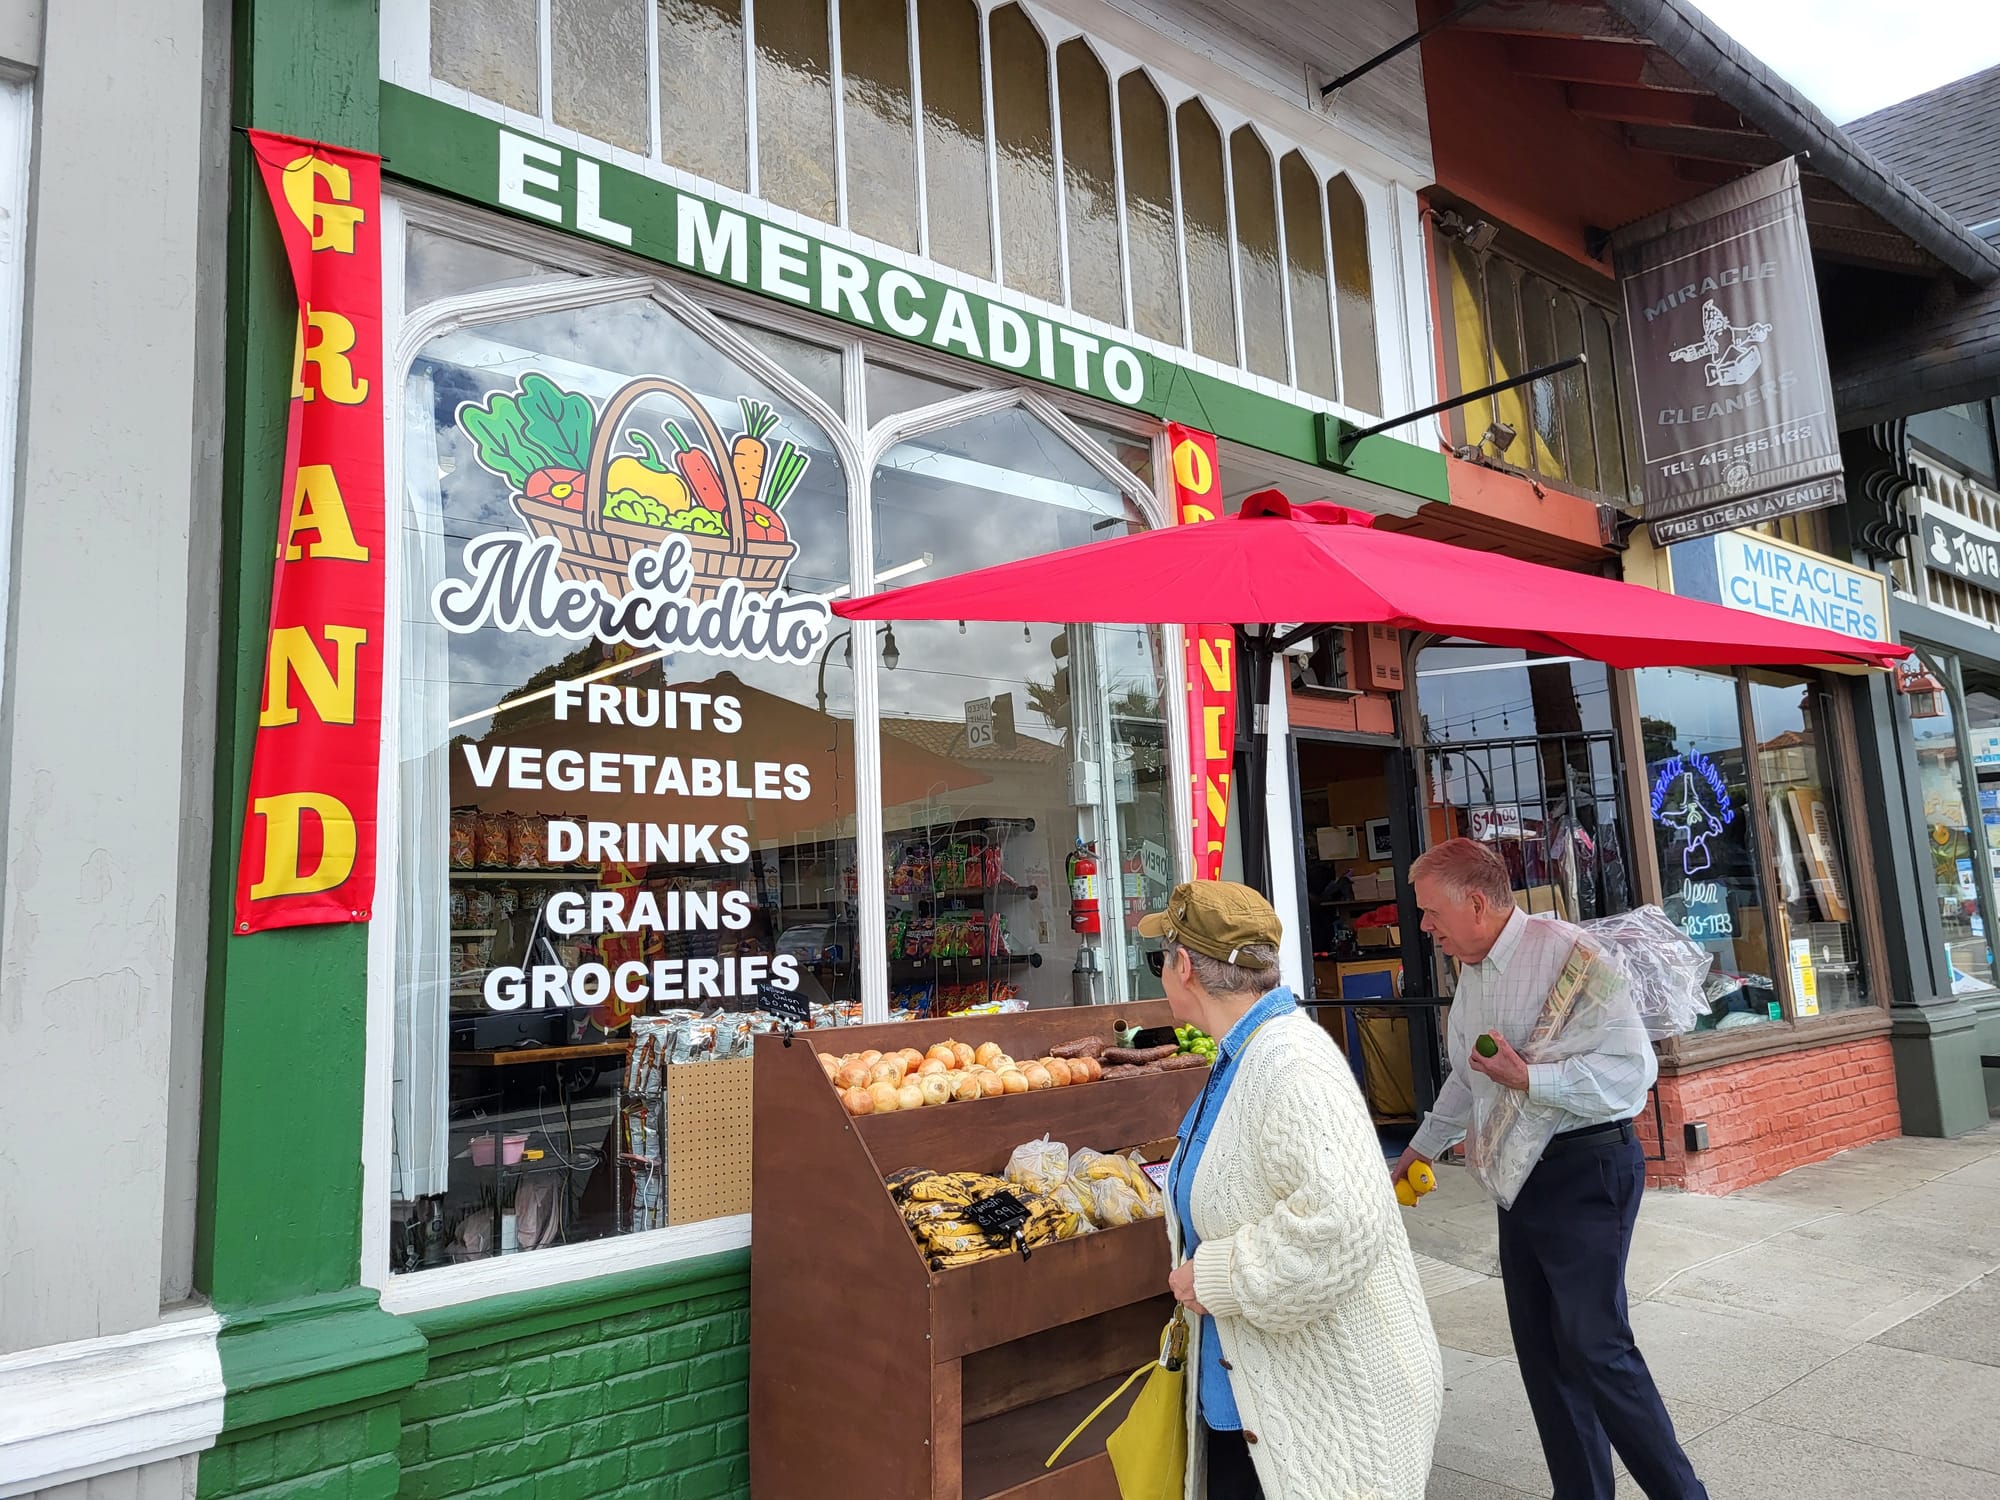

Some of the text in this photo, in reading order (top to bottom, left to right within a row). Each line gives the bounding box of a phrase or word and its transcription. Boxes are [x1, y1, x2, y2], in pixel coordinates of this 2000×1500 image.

[499, 129, 1145, 405] EL MERCADITO
[1642, 261, 1777, 322] MIRACLE
[1658, 370, 1799, 426] CLEANERS
[1660, 462, 1695, 478] TEL:
[1699, 425, 1813, 467] 415.585.1133
[250, 154, 370, 901] GRAND
[1658, 484, 1834, 538] 1708 OCEAN AVENUE
[635, 541, 687, 588] el
[1743, 543, 1864, 606] MIRACLE
[1952, 532, 1999, 579] Java
[438, 540, 828, 660] Mercadito
[1730, 575, 1878, 641] CLEANERS
[1173, 439, 1232, 881] ONIN
[554, 680, 742, 734] FRUITS
[462, 744, 811, 801] VEGETABLES
[547, 821, 750, 864] DRINKS
[546, 891, 751, 934] GRAINS
[484, 954, 800, 1011] GROCERIES
